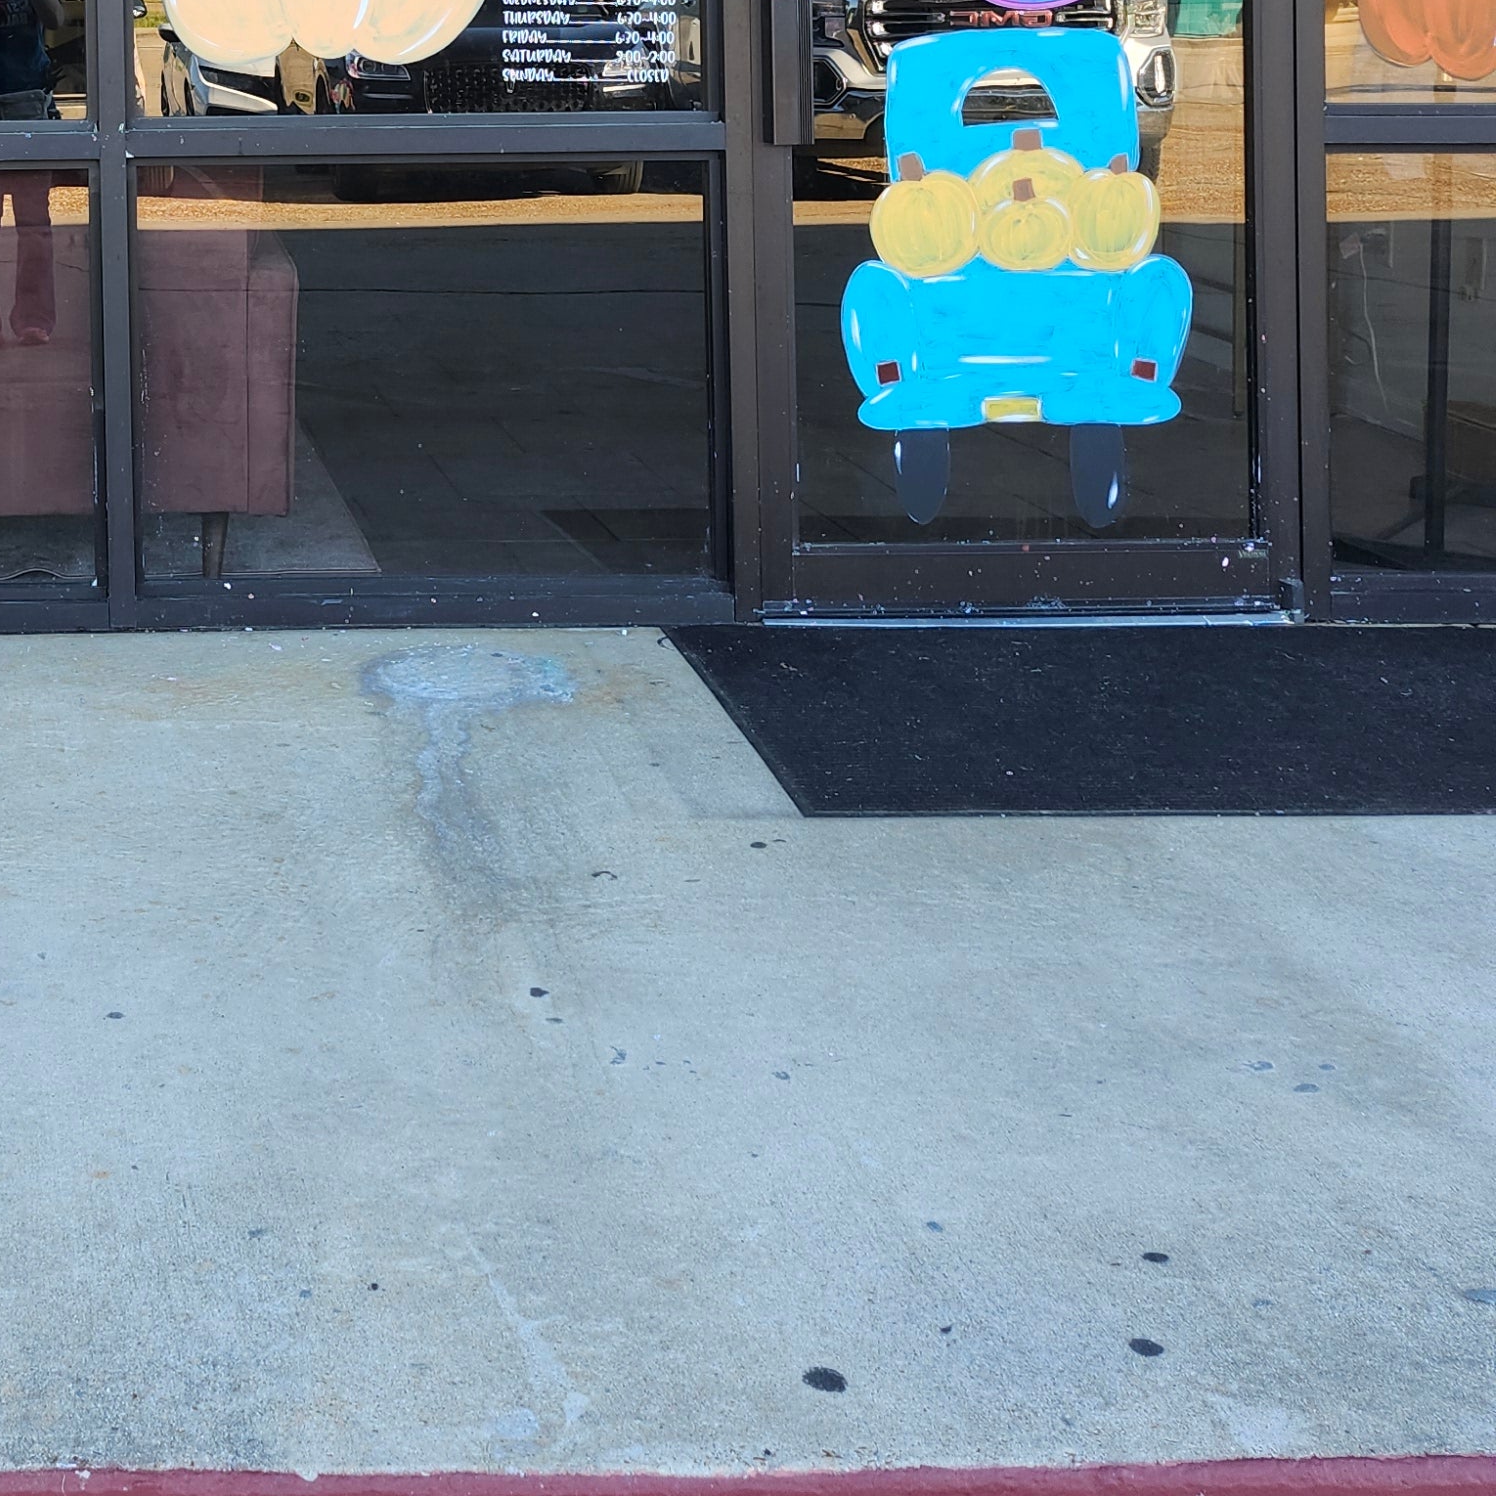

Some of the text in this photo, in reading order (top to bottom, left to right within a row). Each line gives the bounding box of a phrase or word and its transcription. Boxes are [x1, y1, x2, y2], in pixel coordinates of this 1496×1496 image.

[502, 10, 570, 25] THURSDAY
[502, 29, 547, 44] FRIDAY
[502, 49, 571, 63] SATURDAY
[502, 67, 669, 83] SUNDAY CLOSED
